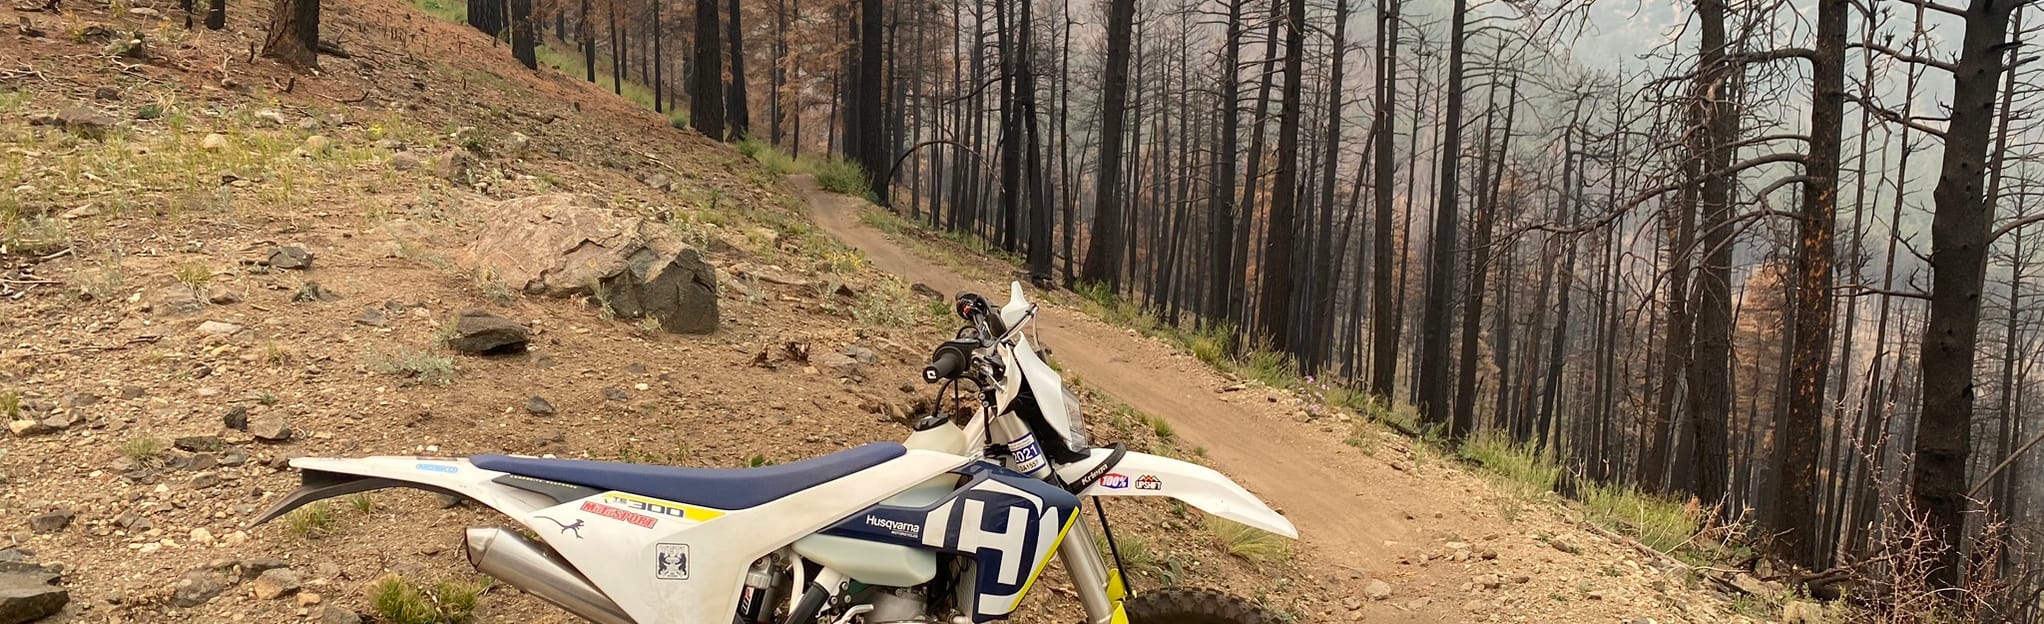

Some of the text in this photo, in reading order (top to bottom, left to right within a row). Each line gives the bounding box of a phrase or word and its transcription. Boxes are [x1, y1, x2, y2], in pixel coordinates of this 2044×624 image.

[1012, 444, 1038, 463] 2021
[1102, 475, 1127, 488] 100%
[627, 499, 684, 518] 300
[866, 514, 920, 533] Husqvarna
